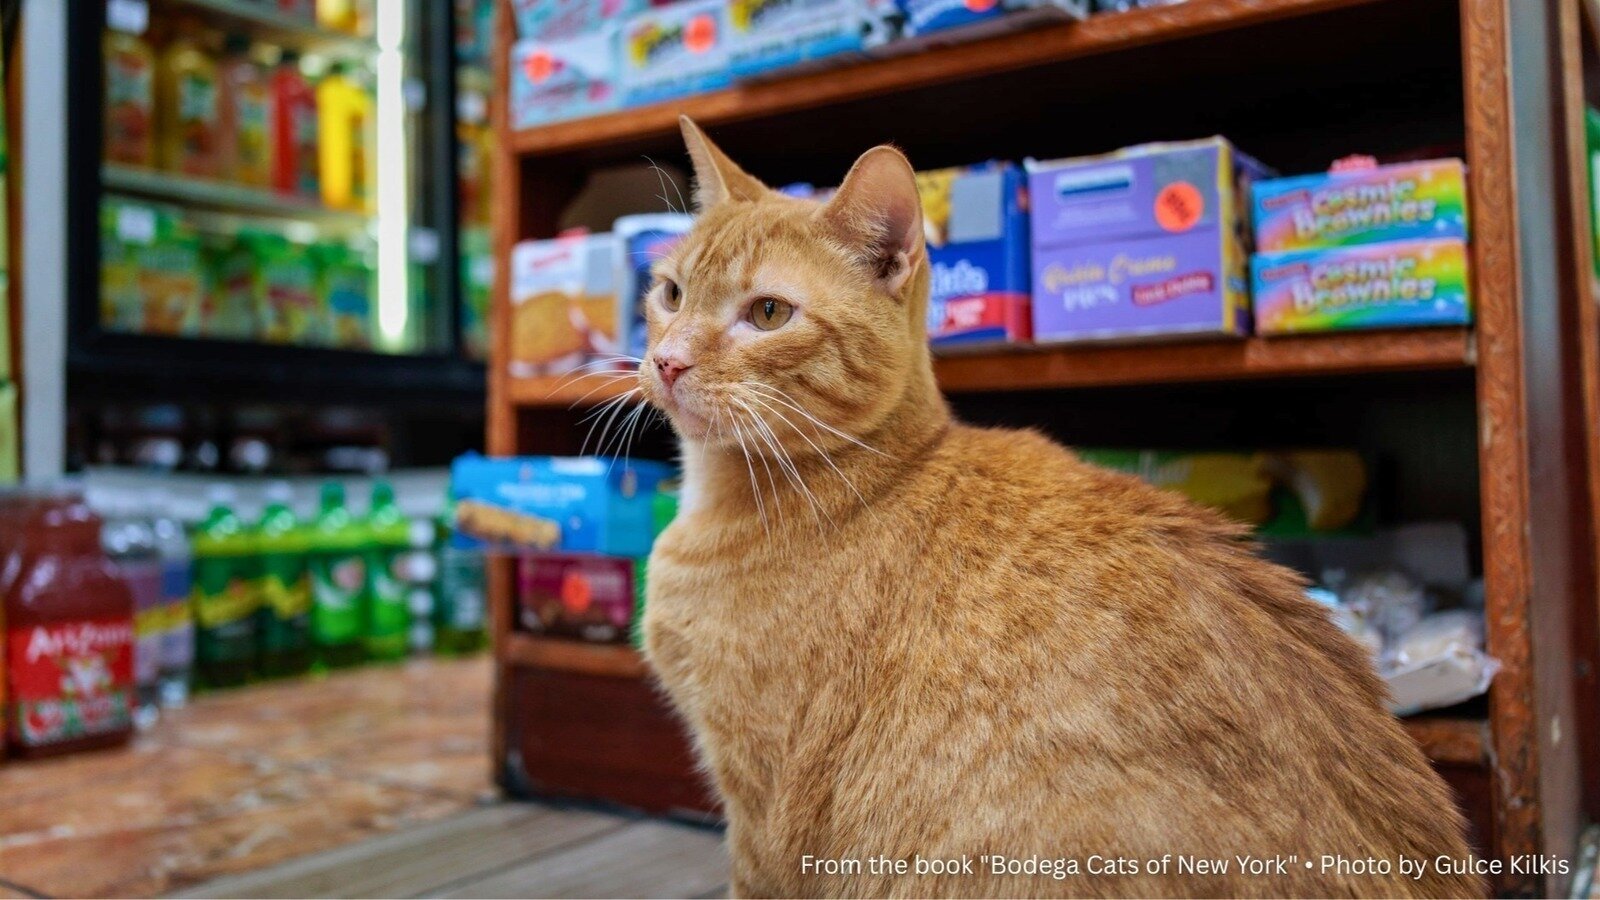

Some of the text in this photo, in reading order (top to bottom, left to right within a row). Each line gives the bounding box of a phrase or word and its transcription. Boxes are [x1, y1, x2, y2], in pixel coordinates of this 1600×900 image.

[1312, 178, 1416, 215] Cosmic
[1293, 199, 1436, 239] Brownies
[1312, 256, 1416, 289] Cosmic
[1291, 277, 1436, 314] Brownies
